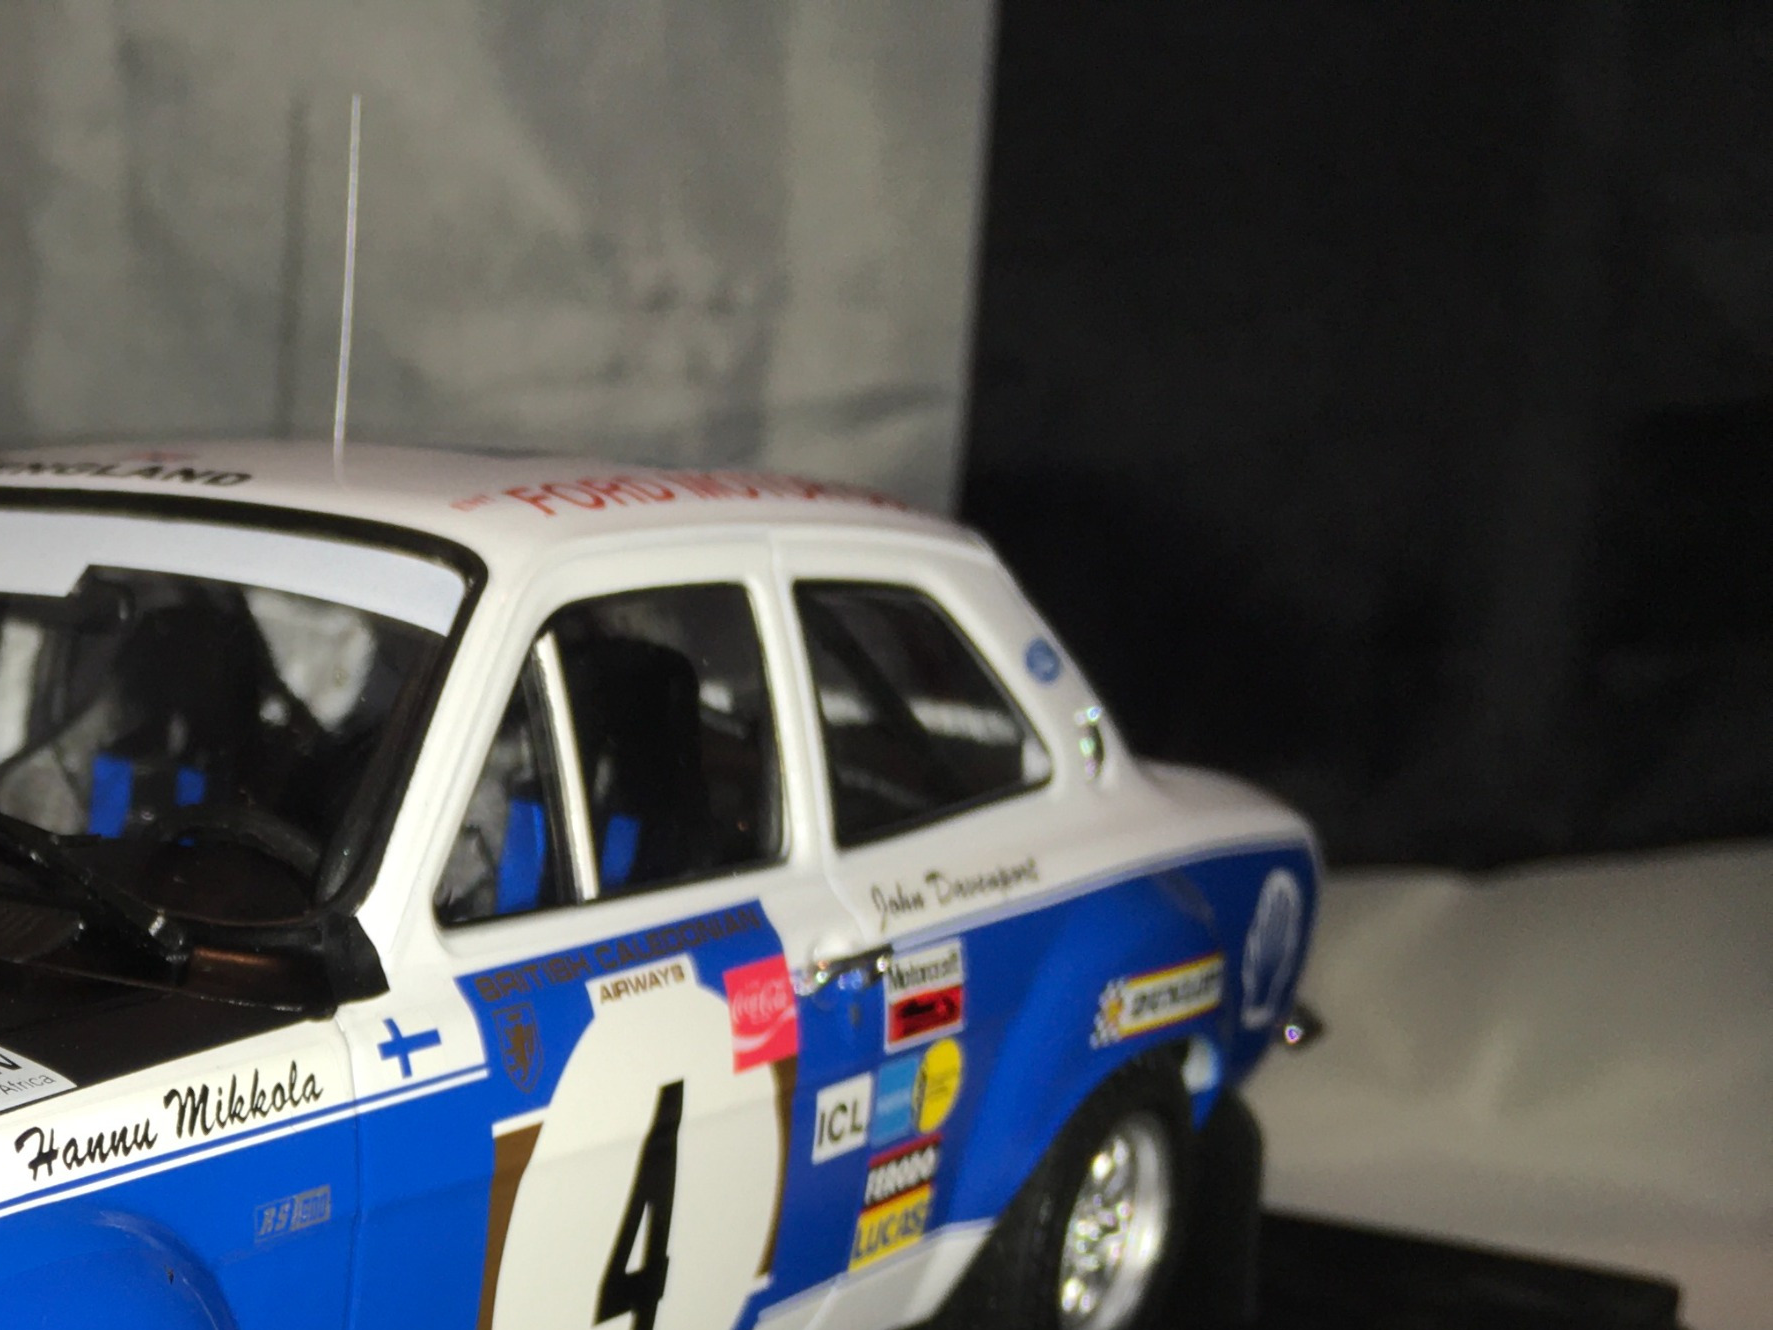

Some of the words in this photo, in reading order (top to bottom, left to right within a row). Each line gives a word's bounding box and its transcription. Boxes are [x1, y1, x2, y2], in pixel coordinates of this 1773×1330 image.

[477, 955, 592, 1002] BRITISH
[594, 907, 762, 970] CALEDONIAN
[599, 963, 686, 1005] AIRWAYS
[14, 1118, 159, 1182] Hannu
[163, 1059, 324, 1139] Mikkola
[817, 1099, 864, 1148] ICL
